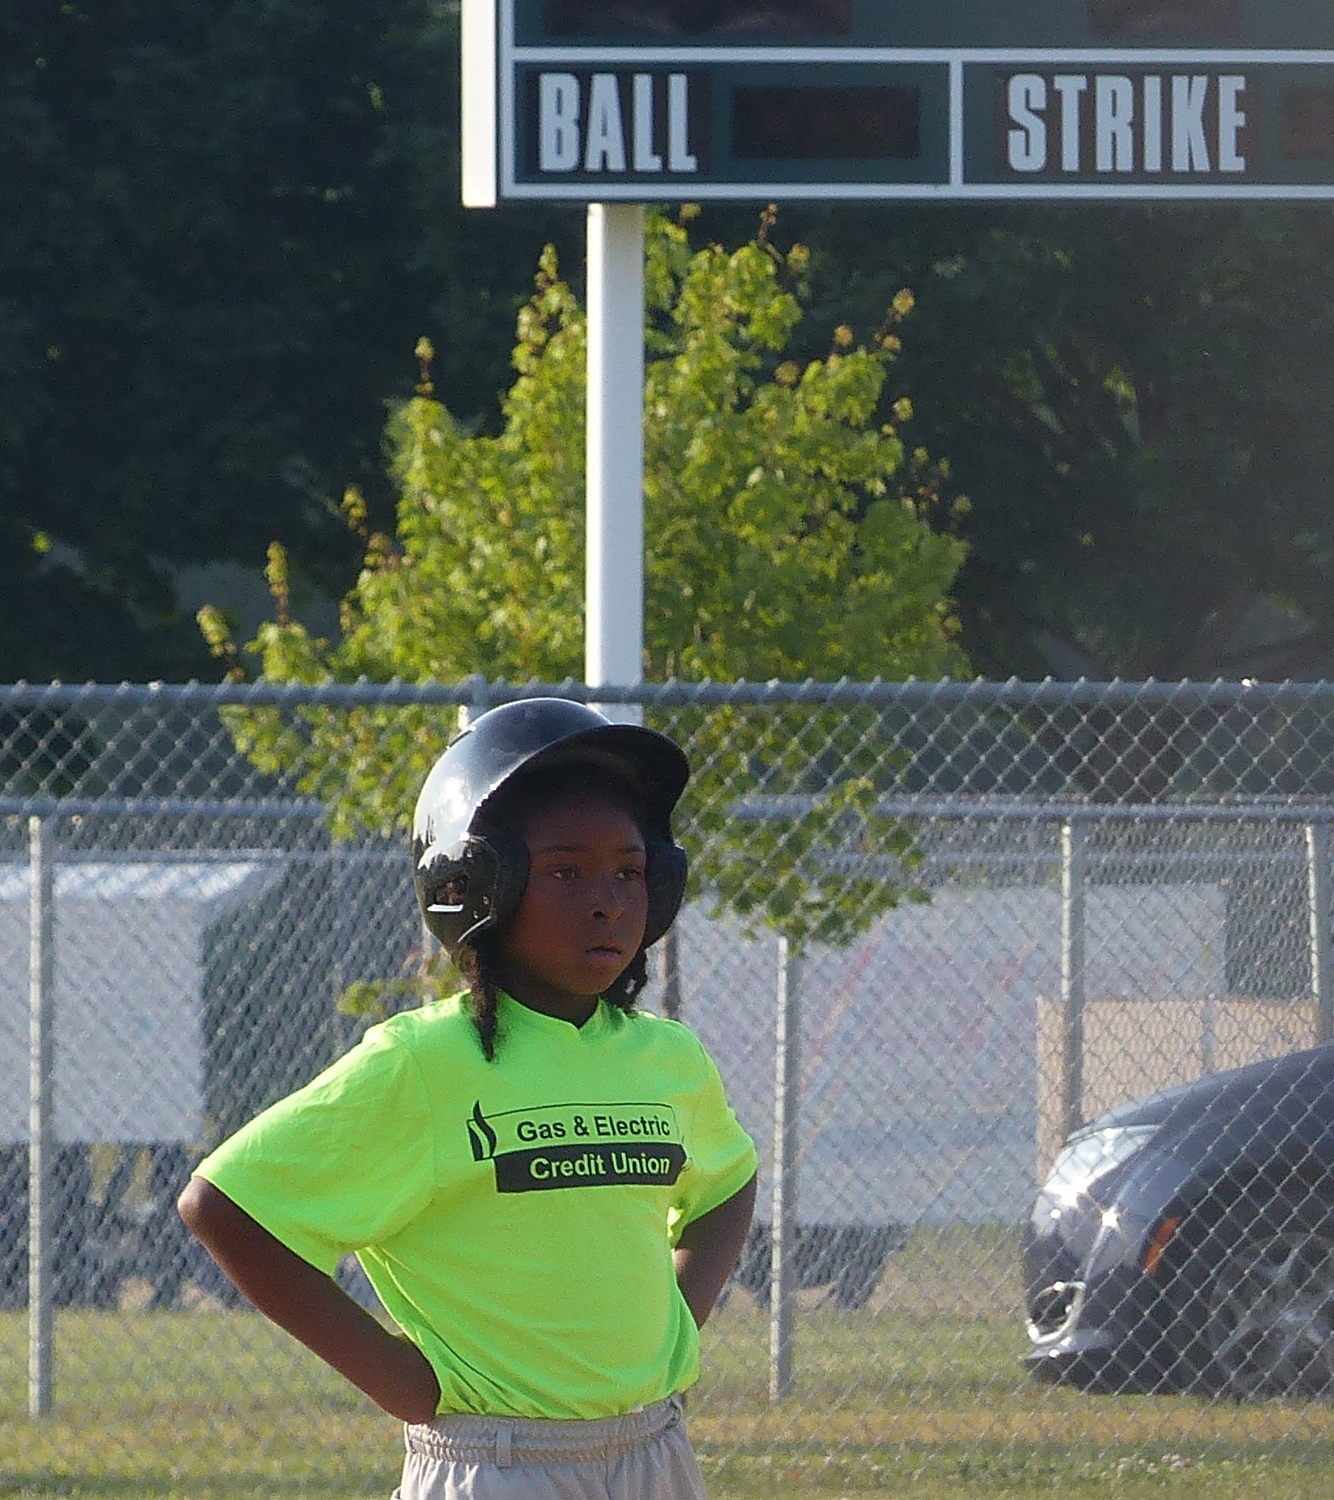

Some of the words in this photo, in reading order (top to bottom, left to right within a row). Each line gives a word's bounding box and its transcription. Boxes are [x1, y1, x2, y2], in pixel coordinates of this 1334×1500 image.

[538, 73, 698, 173] BALL
[1006, 74, 1248, 174] STRIKE
[517, 1120, 566, 1142] Gas
[573, 1115, 590, 1136] &
[594, 1114, 670, 1136] Electric
[530, 1152, 607, 1180] Credit
[611, 1151, 670, 1175] Union
